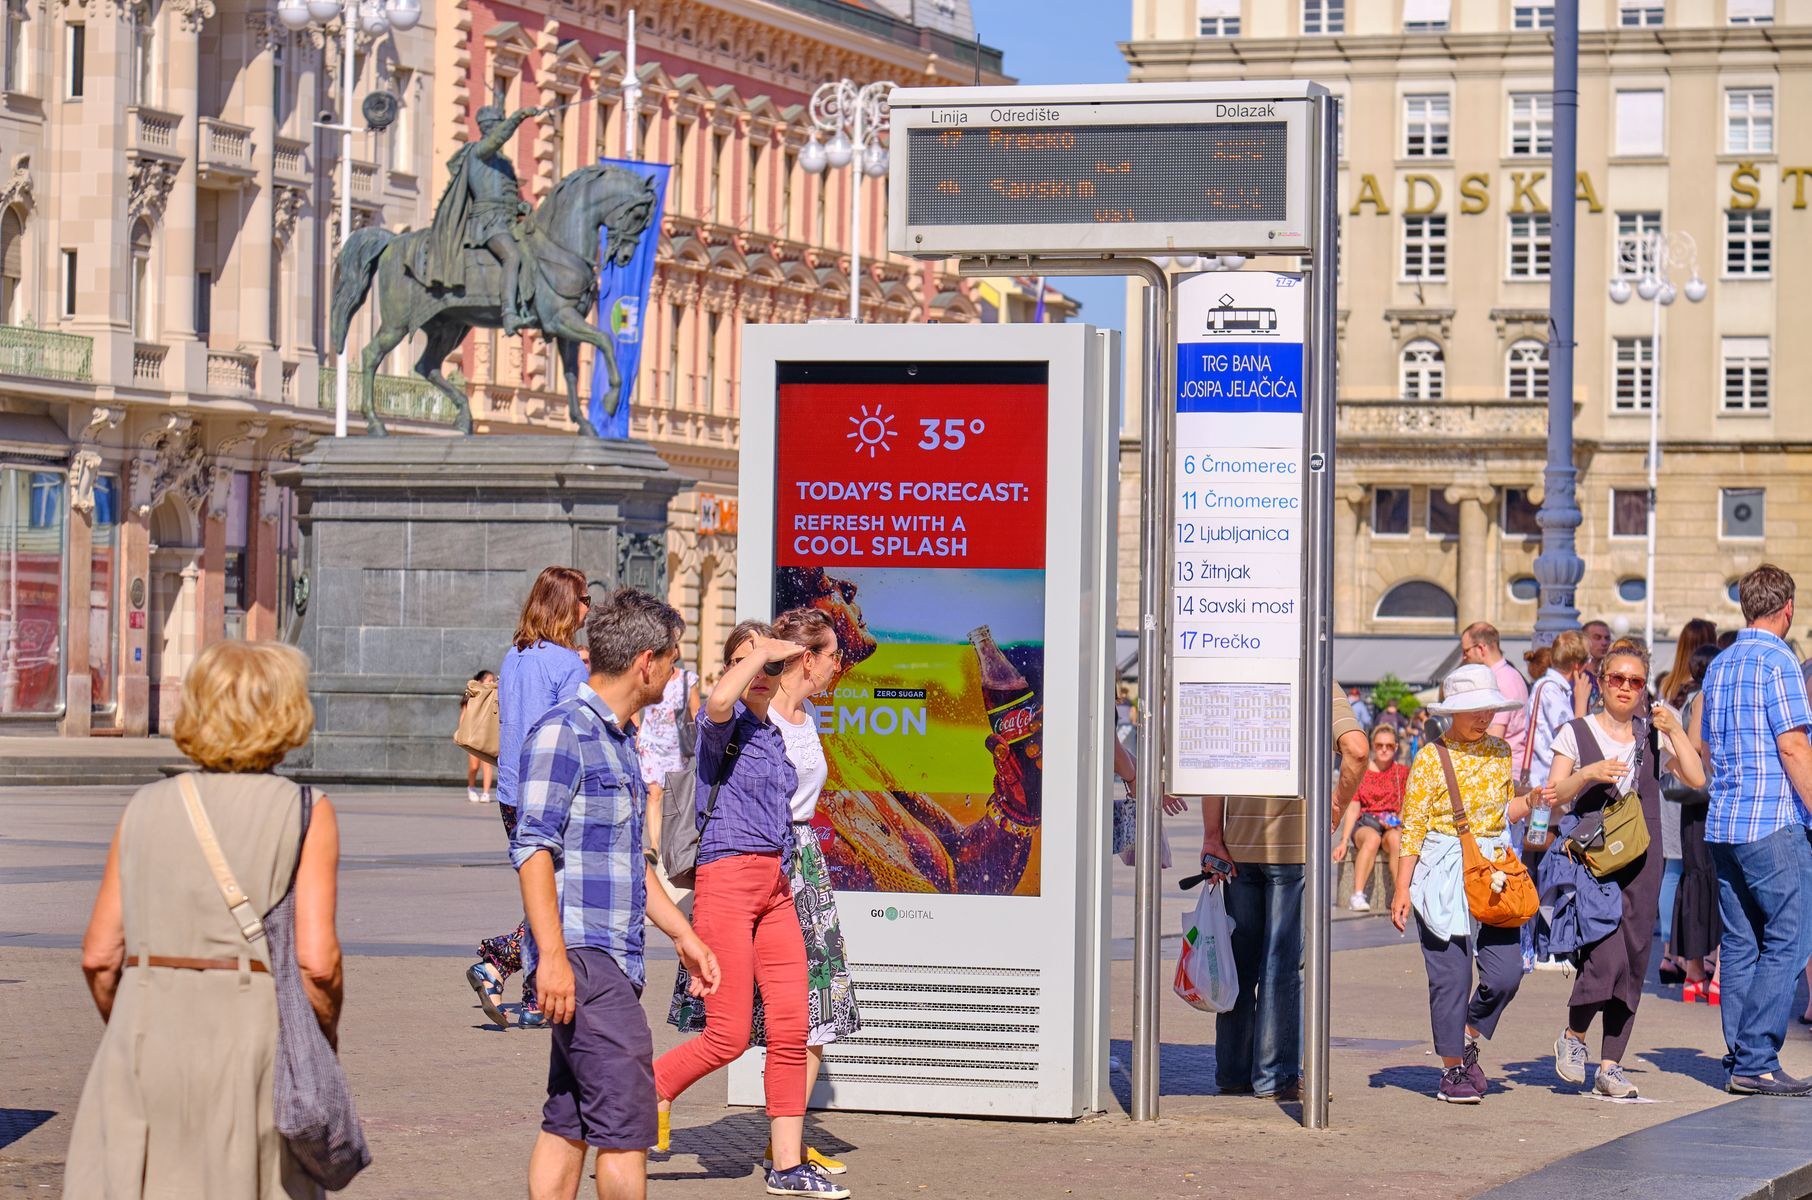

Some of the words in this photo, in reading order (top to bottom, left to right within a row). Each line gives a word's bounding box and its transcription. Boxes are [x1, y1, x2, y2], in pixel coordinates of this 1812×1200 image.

[931, 110, 968, 126] Linija
[990, 108, 1060, 122] Odredište
[1216, 104, 1276, 118] Dolazak
[1350, 172, 1604, 215] ADSKA
[1202, 355, 1228, 372] TRG
[1232, 355, 1272, 372] BANA
[1180, 380, 1224, 399] JOSIPA
[1226, 375, 1298, 399] JELAČIĆA
[917, 418, 986, 451] 35°
[1184, 455, 1196, 475] 6
[1201, 454, 1297, 474] Črnomerec
[795, 481, 893, 501] TODAY'S
[899, 482, 1029, 502] FORECAST:
[1182, 491, 1198, 510] 11
[1204, 489, 1299, 509] Črnomerec
[794, 514, 885, 531] REFRESH
[891, 515, 945, 532] WITH
[951, 516, 967, 532] A
[1177, 523, 1195, 543] 12
[1200, 526, 1290, 544] Ljubljanica
[793, 535, 864, 556] COOL
[871, 536, 967, 557] SPLASH
[1177, 561, 1194, 581] 13
[1200, 559, 1251, 582] Žitnjak
[1177, 595, 1194, 616] 14
[1199, 597, 1246, 614] Savski
[1251, 599, 1295, 614] most
[1180, 631, 1198, 650] 17
[1202, 633, 1261, 650] Prečko
[811, 688, 870, 699] CA-COLA
[876, 690, 897, 698] ZERO
[898, 690, 924, 699] SUGAR
[815, 705, 927, 736] EMON
